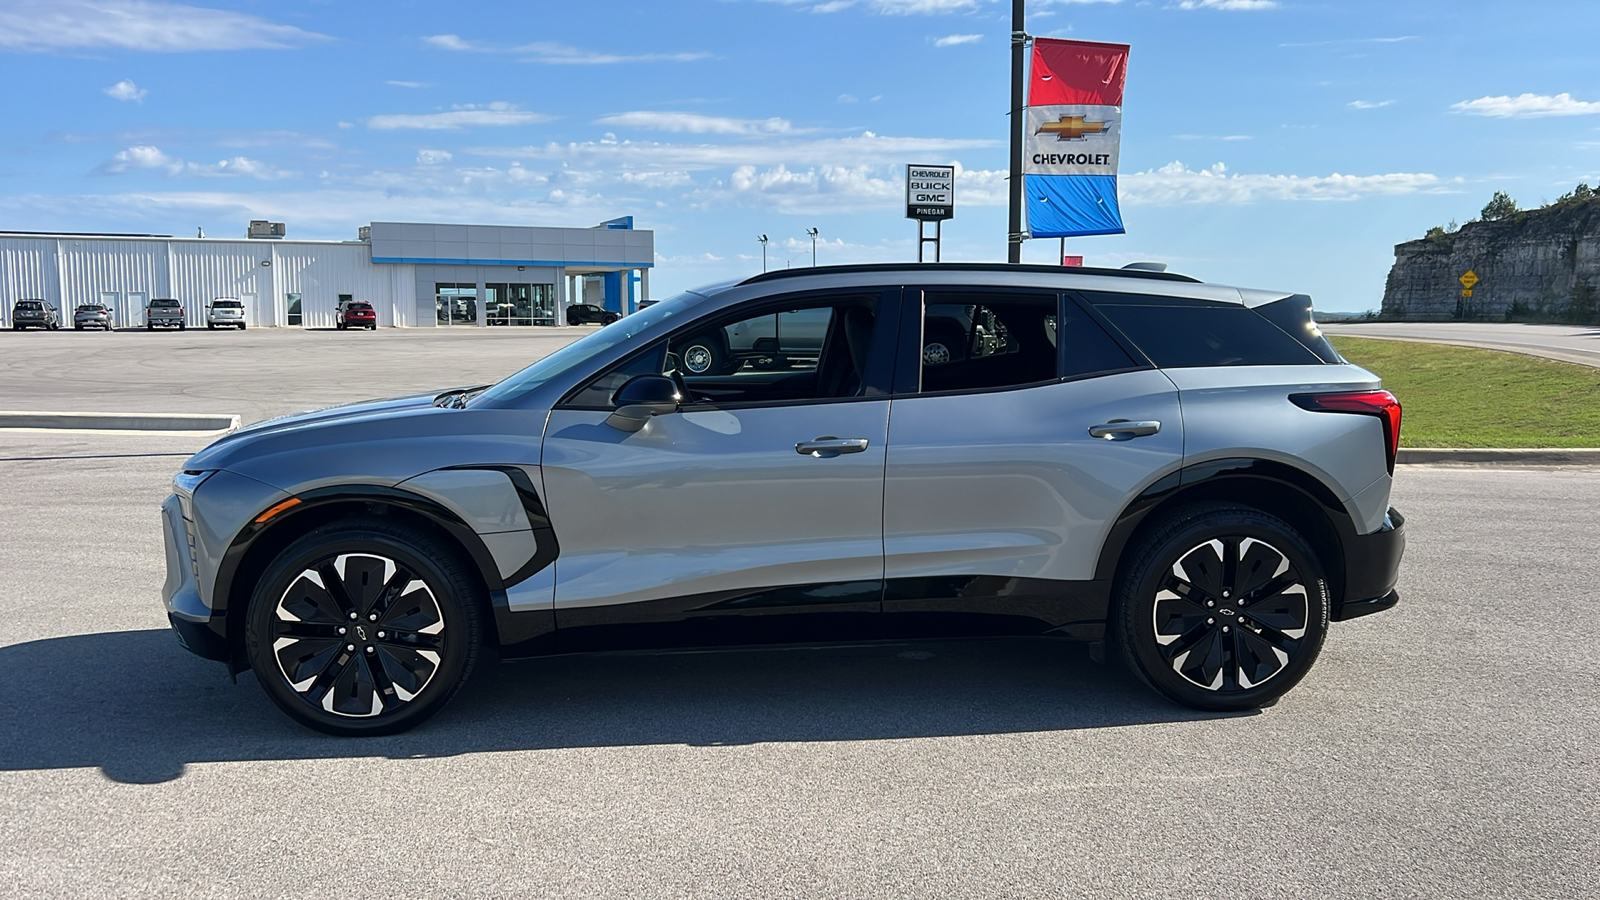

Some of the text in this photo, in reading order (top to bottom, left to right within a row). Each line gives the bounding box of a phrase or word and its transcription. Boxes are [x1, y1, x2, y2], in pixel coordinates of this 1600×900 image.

[912, 170, 950, 178] CHEVROLET
[911, 182, 950, 190] BUICK
[916, 194, 945, 202] GMC
